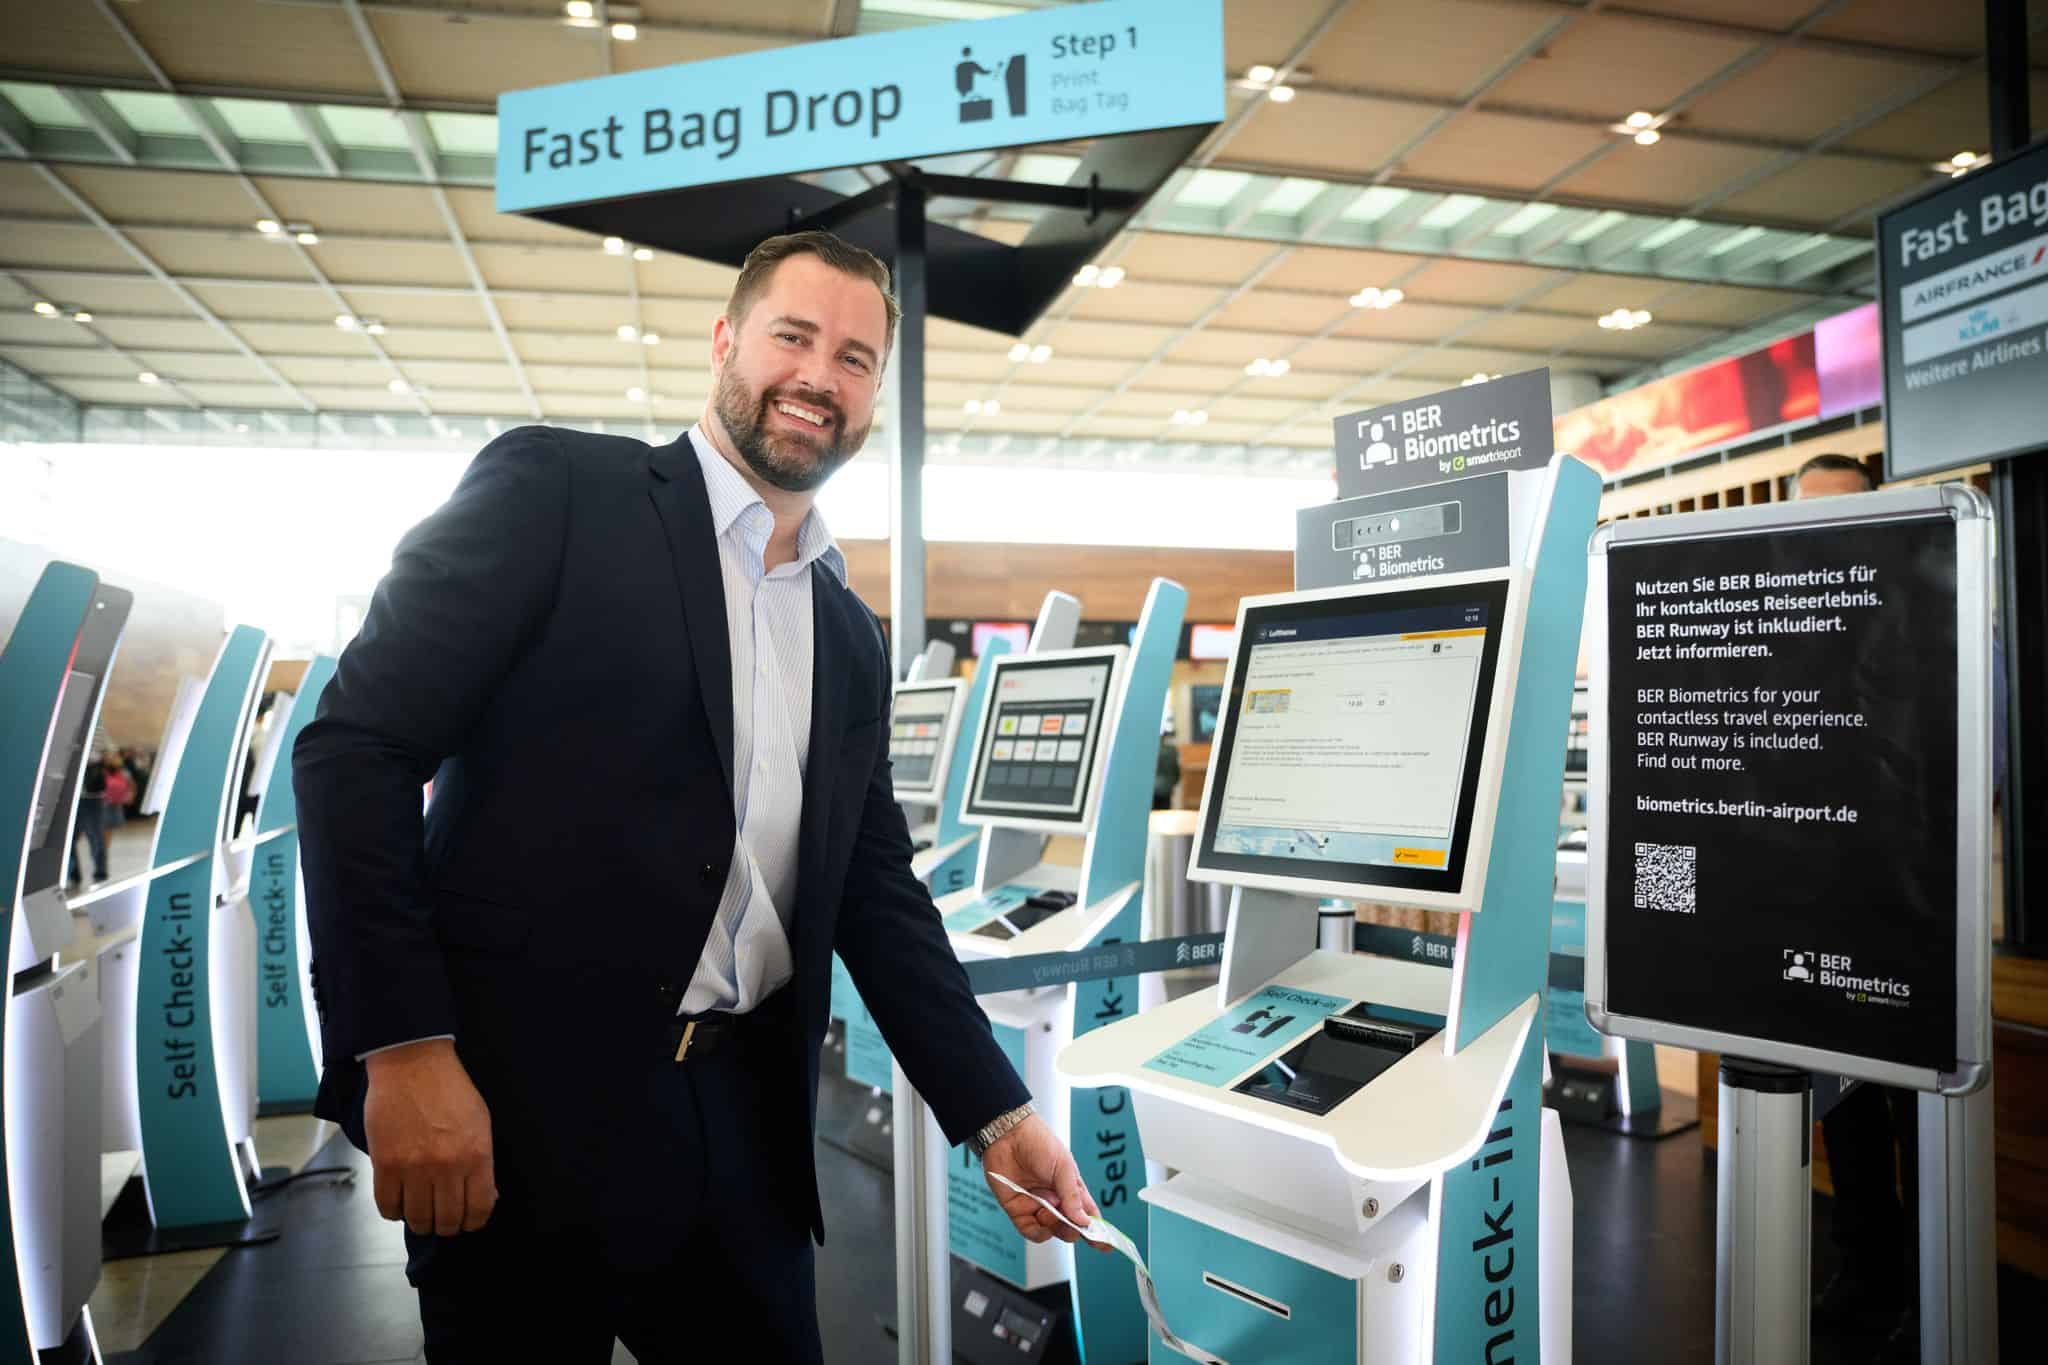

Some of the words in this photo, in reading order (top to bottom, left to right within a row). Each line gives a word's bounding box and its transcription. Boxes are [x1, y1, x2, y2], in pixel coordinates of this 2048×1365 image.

[1051, 33, 1116, 60] Step
[1125, 26, 1137, 50] 1
[1051, 69, 1099, 91] Print
[1051, 97, 1087, 117] Bag
[1094, 91, 1129, 112] Tag
[523, 114, 624, 174] Fast
[643, 106, 741, 160] Bag
[765, 83, 902, 138] Drop
[1901, 208, 1969, 268] Fast
[1981, 181, 2048, 236] Bag
[1904, 359, 1969, 391] Weitere
[1972, 336, 2041, 372] Airlines
[1402, 404, 1442, 434] BER
[1404, 418, 1520, 461] Biometrics
[1439, 459, 1451, 473] by
[1466, 447, 1522, 466] smartdepart
[1379, 544, 1402, 561] BER
[1379, 556, 1445, 577] Biometrics
[1635, 580, 1689, 596] Nutzen
[1693, 577, 1715, 593] Sie
[1719, 575, 1750, 591] BER
[1755, 568, 1844, 589] Biometrics
[1849, 565, 1877, 584] für
[1636, 602, 1656, 617] Ihr
[1660, 597, 1760, 616] kontaktloses
[1764, 590, 1883, 612] Reiseerlebnis.
[1636, 624, 1665, 639] BER
[1669, 621, 1730, 640] Runway
[1734, 620, 1754, 635] ist
[1758, 615, 1847, 634] inkludiert.
[1635, 645, 1672, 661] Jetzt
[1675, 643, 1773, 660] informieren.
[1637, 689, 1664, 703] BER
[1669, 687, 1749, 703] Biometrics
[1753, 686, 1777, 703] for
[1782, 689, 1820, 707] your
[1637, 710, 1719, 726] contactless
[1723, 710, 1768, 726] travel
[1772, 711, 1868, 730] experience.
[1637, 733, 1664, 747] BER
[1669, 733, 1729, 751] Runway
[1733, 733, 1745, 749] is
[1749, 733, 1824, 751] included.
[1637, 753, 1667, 768] Find
[1671, 756, 1697, 770] out
[1701, 758, 1745, 771] more.
[1636, 796, 1858, 823] biometrics.berlin-airport.de
[262, 854, 286, 955] Check-in
[161, 892, 195, 1029] Check-in
[1192, 943, 1215, 960] BER
[1426, 942, 1448, 959] BER
[1820, 953, 1851, 971] BER
[264, 963, 288, 1008] Self
[1820, 970, 1910, 997] Biometrics
[163, 1038, 197, 1099] Self
[1097, 1130, 1127, 1208] Self
